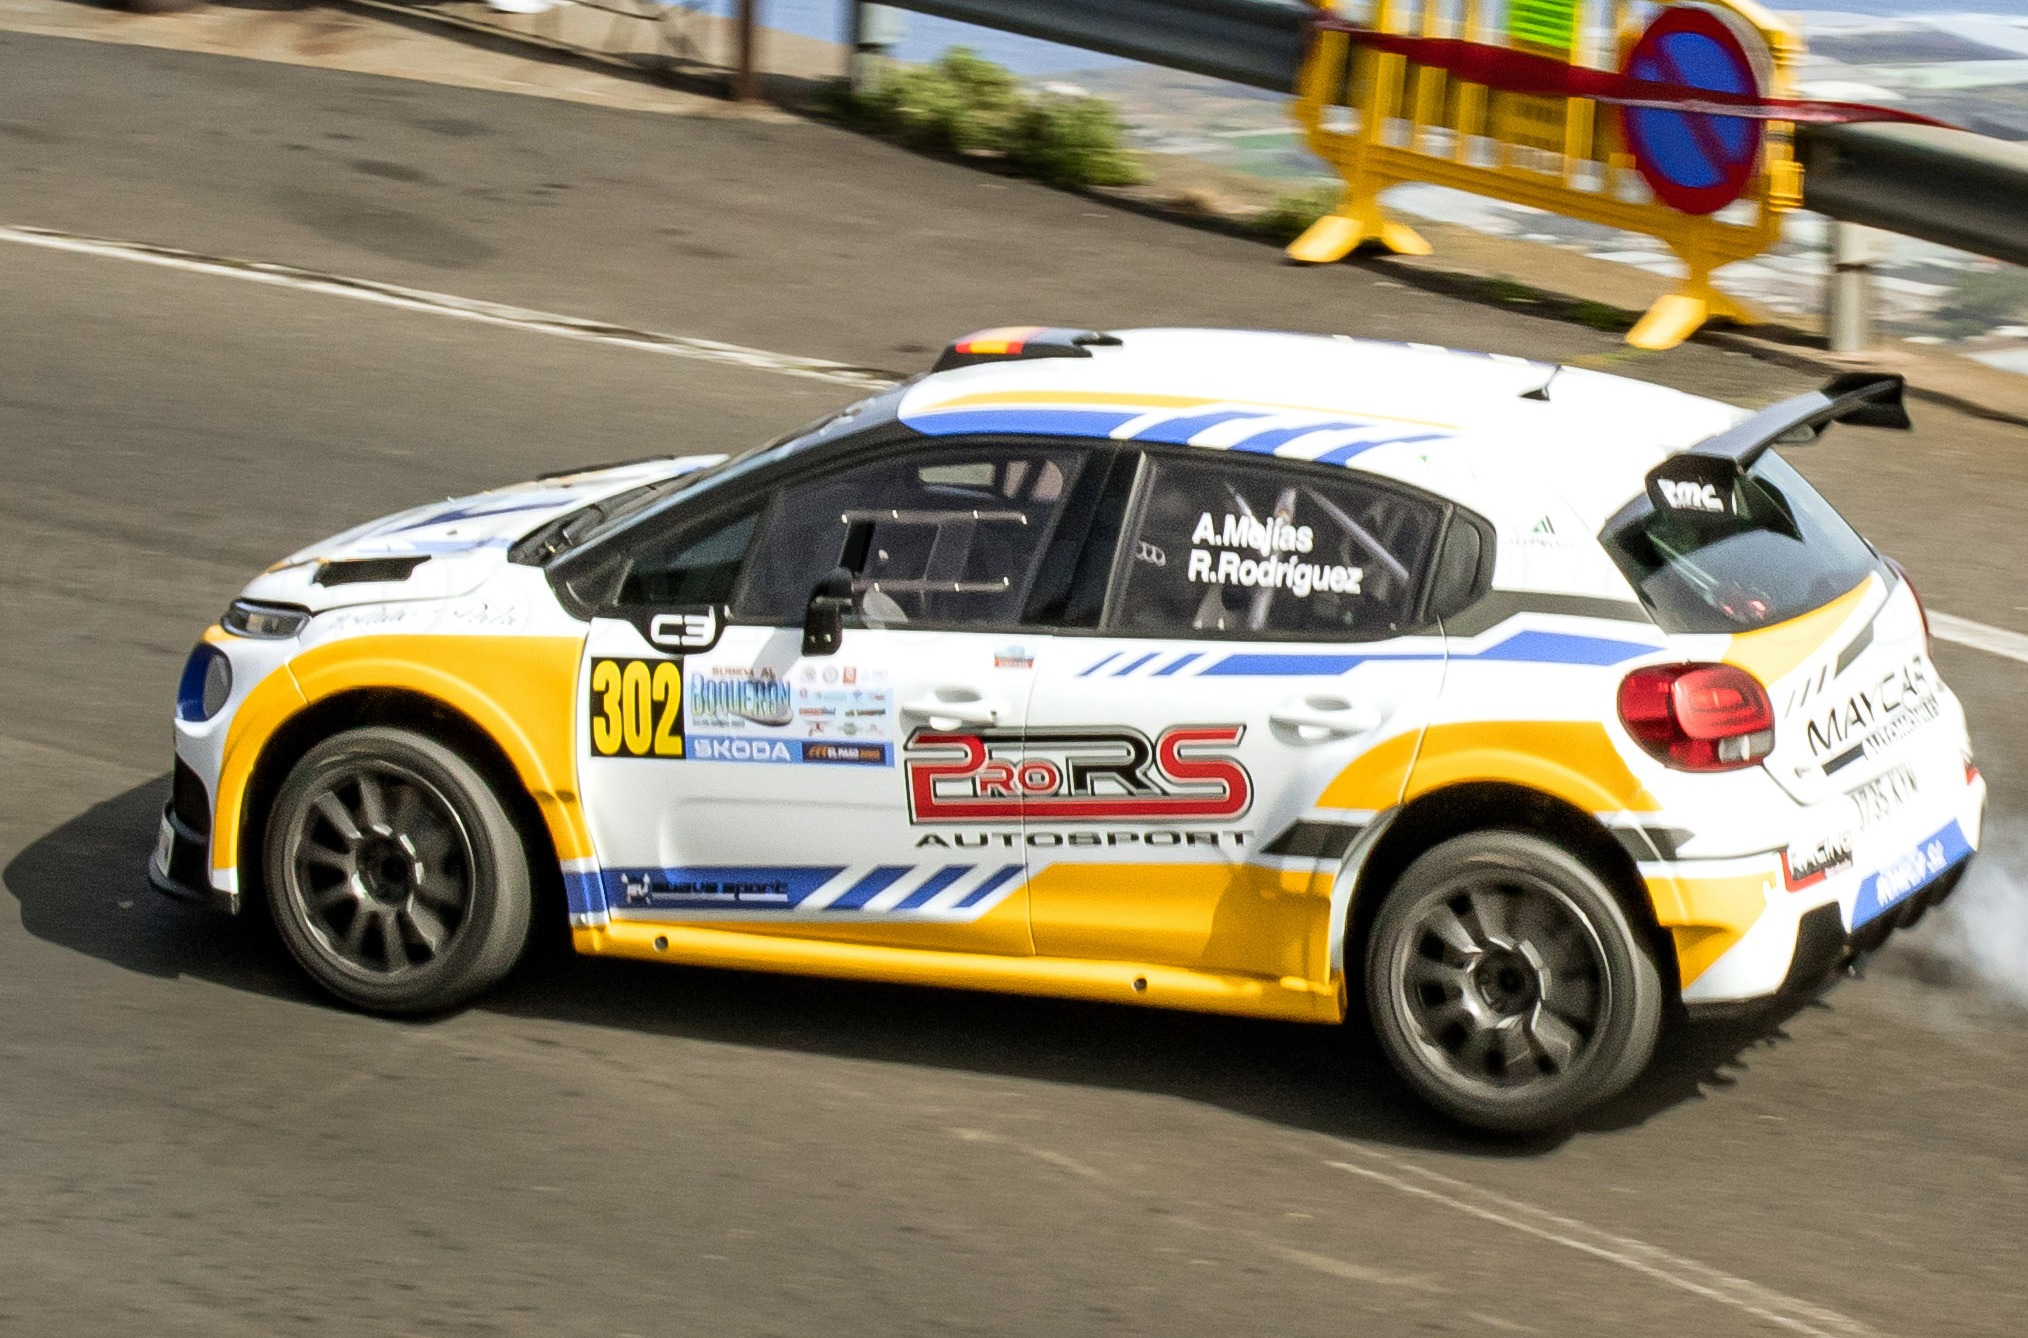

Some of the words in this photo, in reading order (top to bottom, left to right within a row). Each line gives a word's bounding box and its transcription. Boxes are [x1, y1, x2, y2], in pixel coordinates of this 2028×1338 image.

[1187, 548, 1364, 597] R.Rodríguez
[650, 611, 717, 647] C3
[593, 660, 682, 756] 302
[914, 830, 1254, 848] AUTOSPORT
